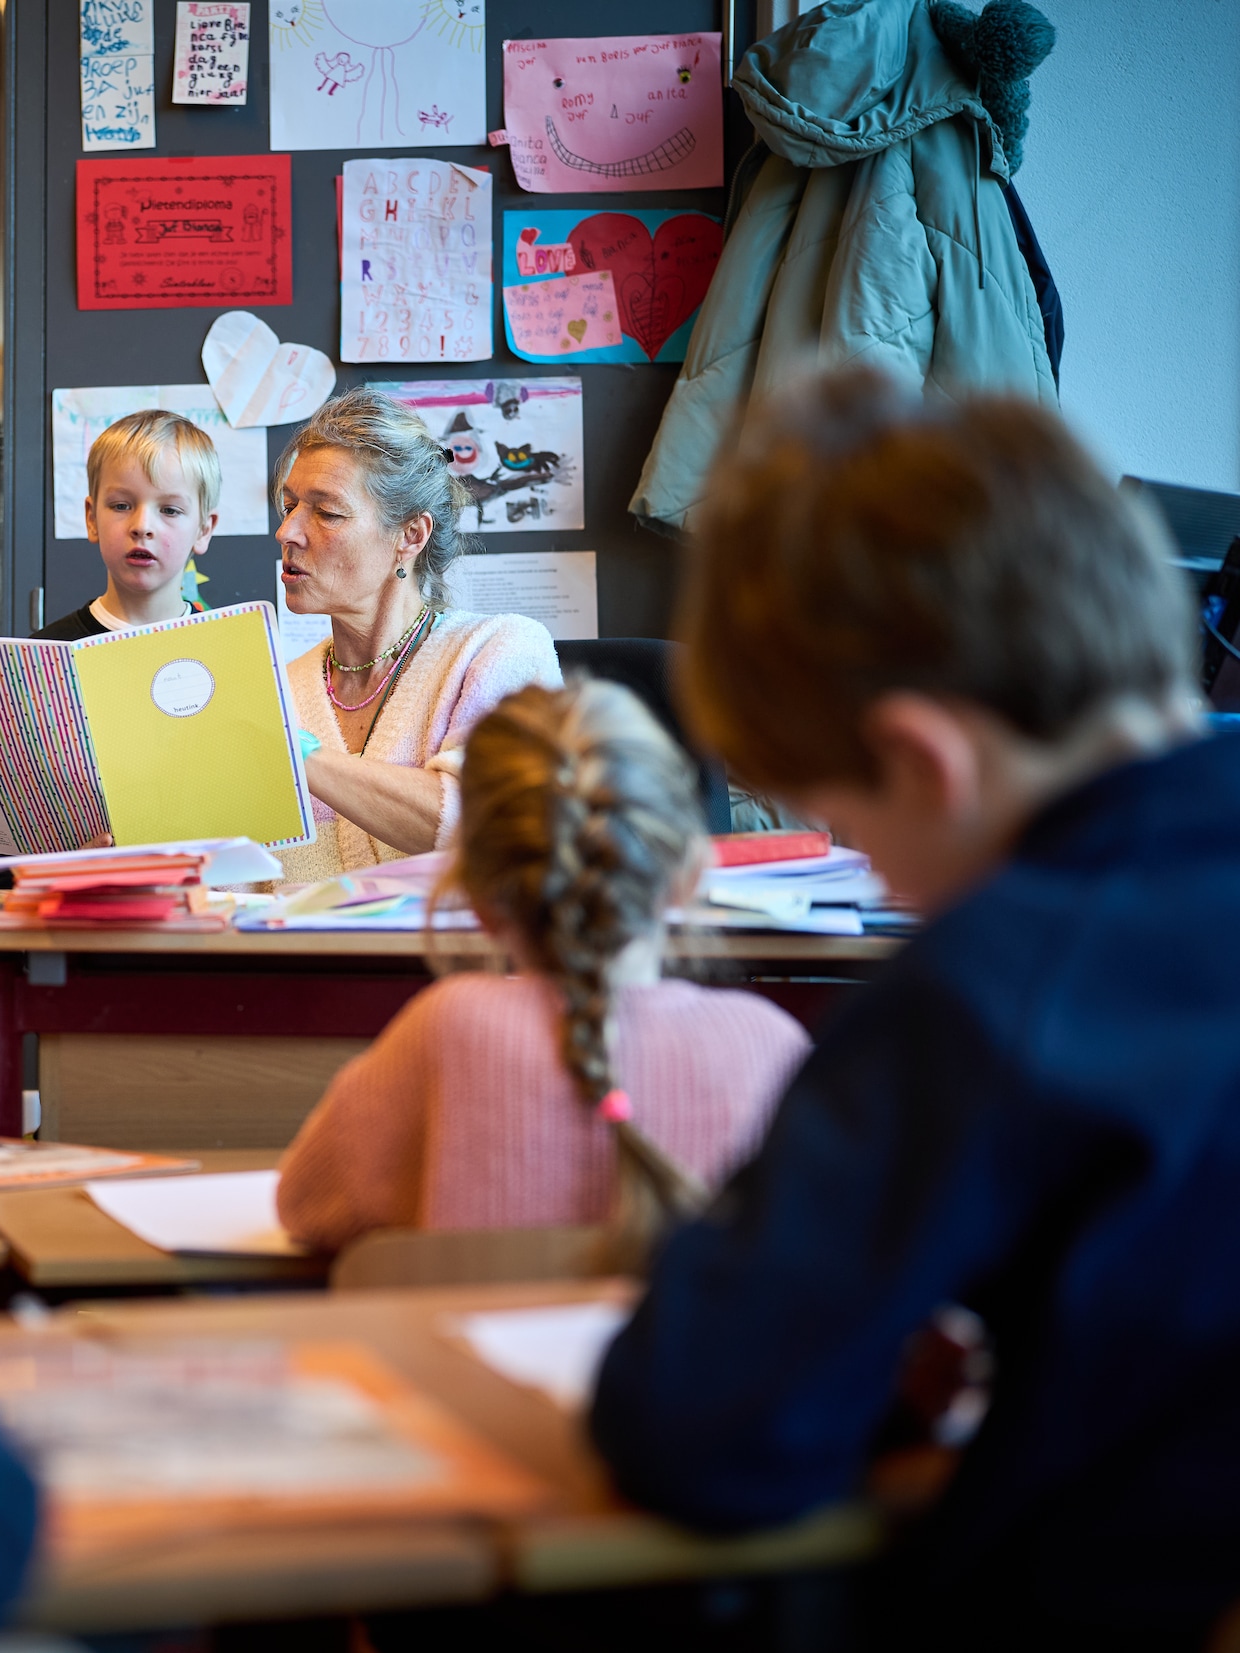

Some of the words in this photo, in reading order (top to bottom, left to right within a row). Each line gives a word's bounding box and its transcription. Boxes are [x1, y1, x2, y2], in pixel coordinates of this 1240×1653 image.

[82, 104, 106, 121] en
[362, 172, 378, 195] A
[407, 170, 420, 194] C
[429, 171, 442, 195] D
[360, 199, 376, 223] G
[385, 199, 398, 222] H
[464, 196, 475, 221] L
[362, 259, 373, 282] R
[518, 248, 576, 275] LOVE
[375, 311, 388, 333] 2
[398, 309, 411, 332] 3
[443, 309, 454, 330] 5
[463, 309, 474, 331] 6
[357, 336, 370, 358] 7
[378, 335, 389, 357] 8
[399, 335, 411, 357] 9
